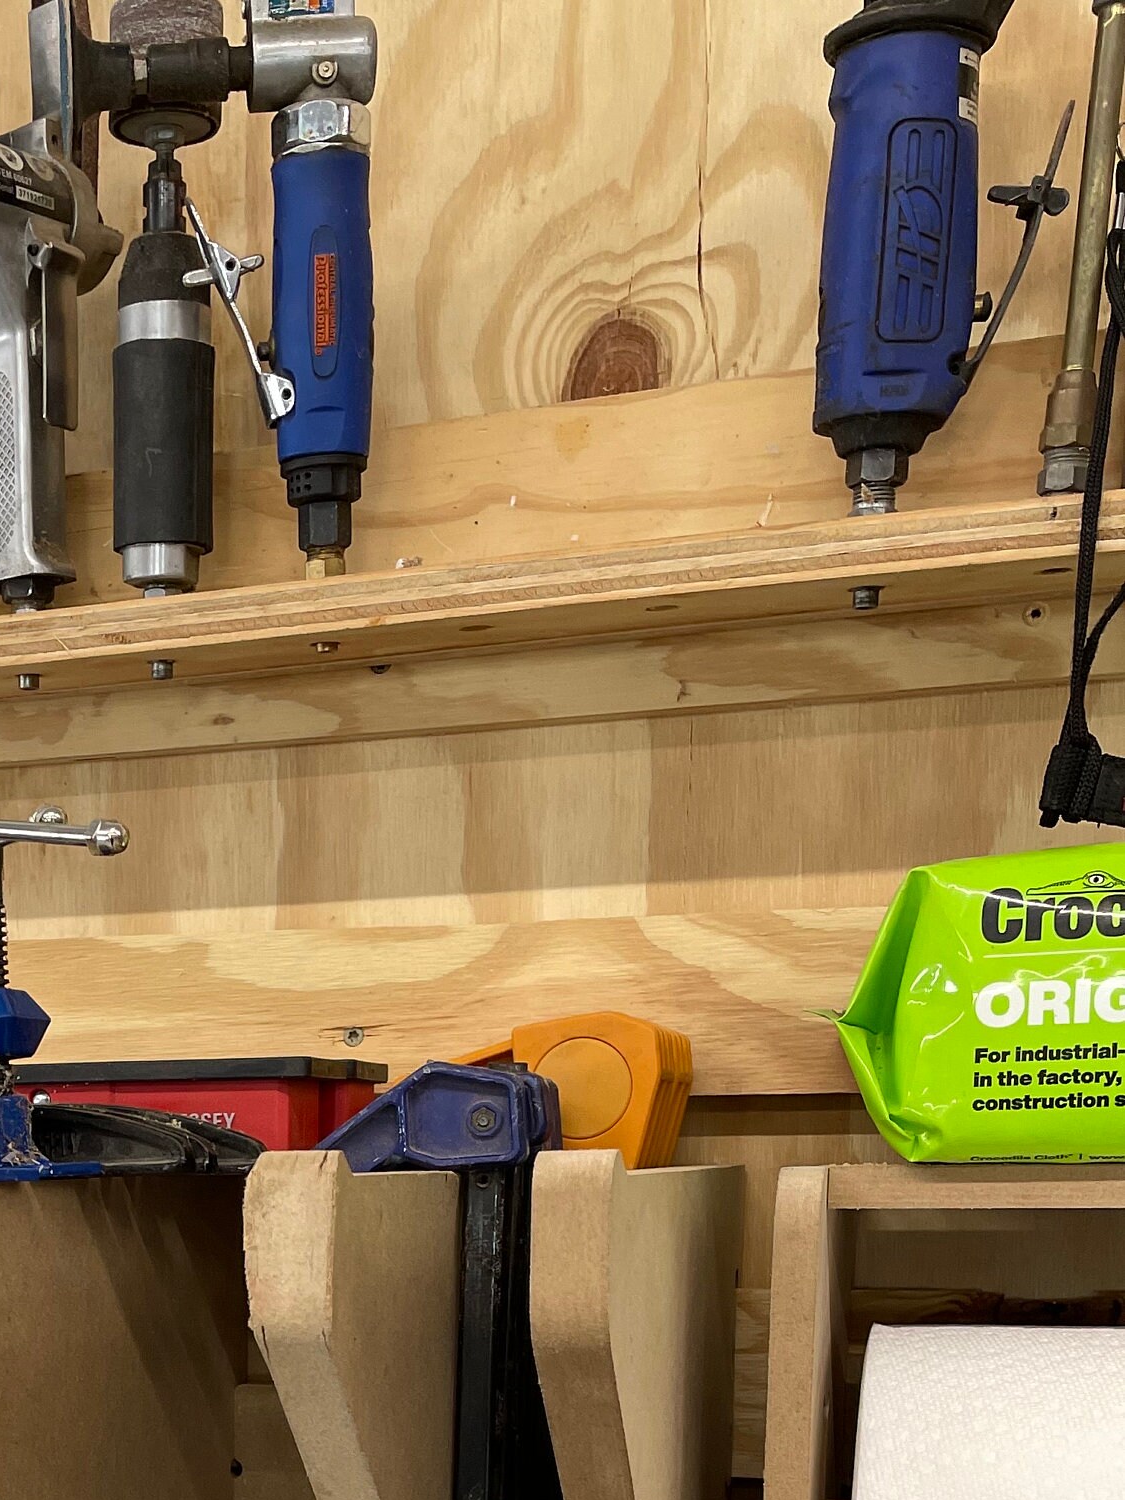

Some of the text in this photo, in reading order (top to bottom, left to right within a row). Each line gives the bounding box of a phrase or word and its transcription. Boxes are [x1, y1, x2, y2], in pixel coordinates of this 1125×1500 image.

[316, 256, 328, 346] Professional
[974, 1043, 1125, 1064] For industrial-
[973, 1069, 1122, 1087] in the factory,
[972, 1095, 1110, 1111] construction
